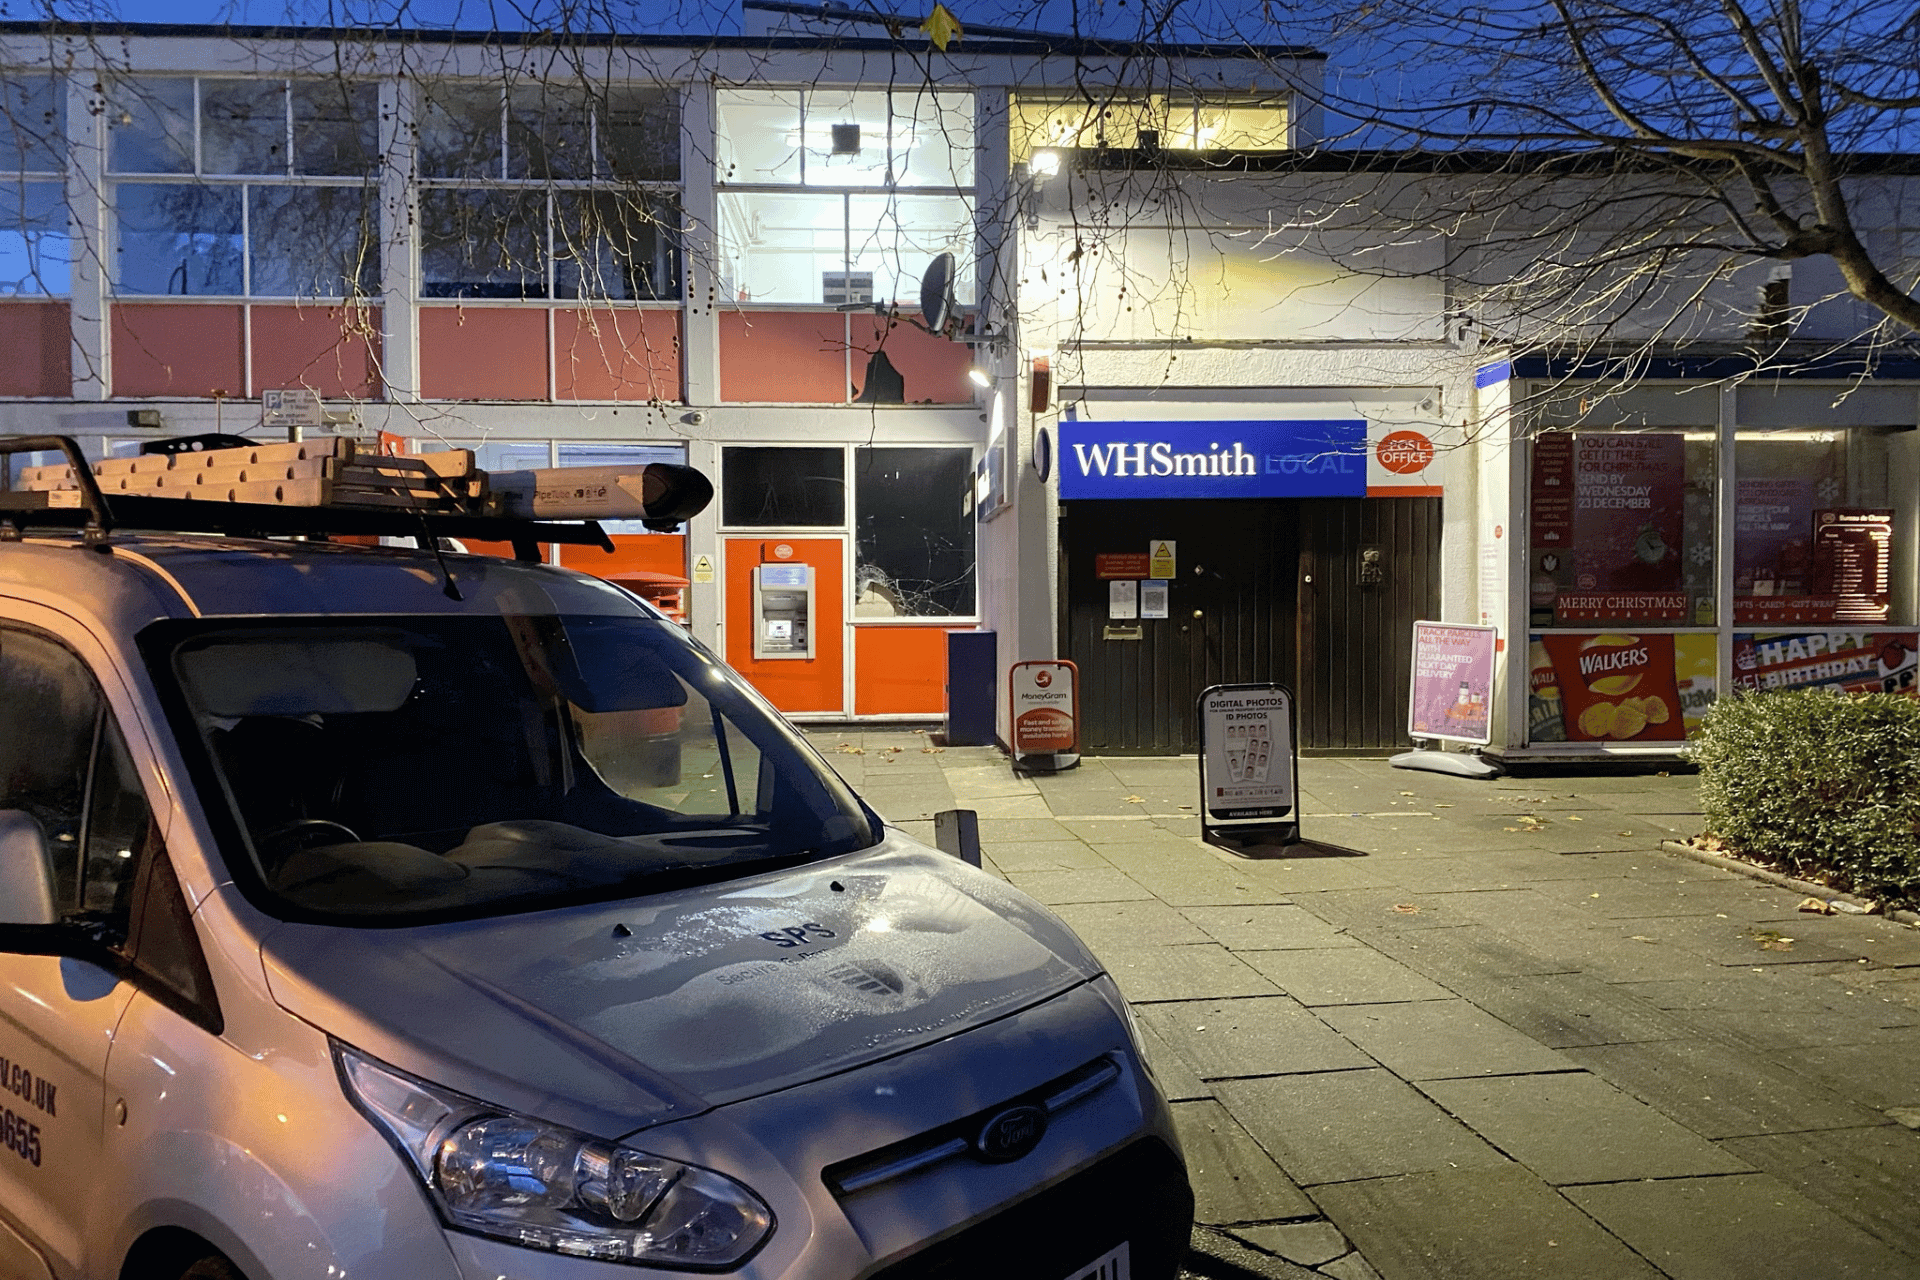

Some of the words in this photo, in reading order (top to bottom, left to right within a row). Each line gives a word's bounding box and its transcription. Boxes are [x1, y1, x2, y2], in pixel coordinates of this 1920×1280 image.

[1580, 438, 1605, 449] YOU
[1607, 438, 1635, 449] CAN
[1073, 442, 1256, 477] WHSmith
[1382, 452, 1427, 463] OFFICE
[1579, 451, 1598, 460] GET
[1600, 451, 1611, 460] IT
[1615, 450, 1646, 461] THERE
[1265, 454, 1354, 475] LOCAL
[1578, 462, 1601, 472] FOR
[1578, 474, 1608, 485] SEND
[1610, 474, 1626, 485] BY
[1578, 486, 1651, 497] WEDNESDAY
[1578, 498, 1593, 509] 23
[1593, 498, 1651, 509] DECEMBER
[1558, 597, 1604, 609] MERRY
[1606, 596, 1687, 608] CHRISTMAS!
[1419, 627, 1445, 637] TRACK
[1418, 636, 1434, 644] ALL
[1435, 637, 1450, 646] THE
[1451, 638, 1471, 646] WAY
[1418, 643, 1441, 652] WITH
[1761, 633, 1865, 666] HAPPY
[1417, 652, 1473, 664] GUARANTEED
[1579, 647, 1648, 675] WALKERS
[1417, 660, 1439, 669] NEXT
[1440, 662, 1457, 671] DAY
[1766, 653, 1876, 687] BIRTHDAY
[1416, 668, 1454, 679] DELIVERY
[1022, 692, 1067, 701] MoneyGram
[1210, 700, 1243, 708] DIGITAL
[1246, 697, 1283, 707] PHOTOS
[1236, 712, 1268, 720] PHOTOS
[1038, 718, 1050, 726] and
[759, 923, 836, 949] SPS
[715, 963, 779, 986] Secure
[0, 1105, 42, 1168] 655
[1000, 1115, 1035, 1148] Ford
